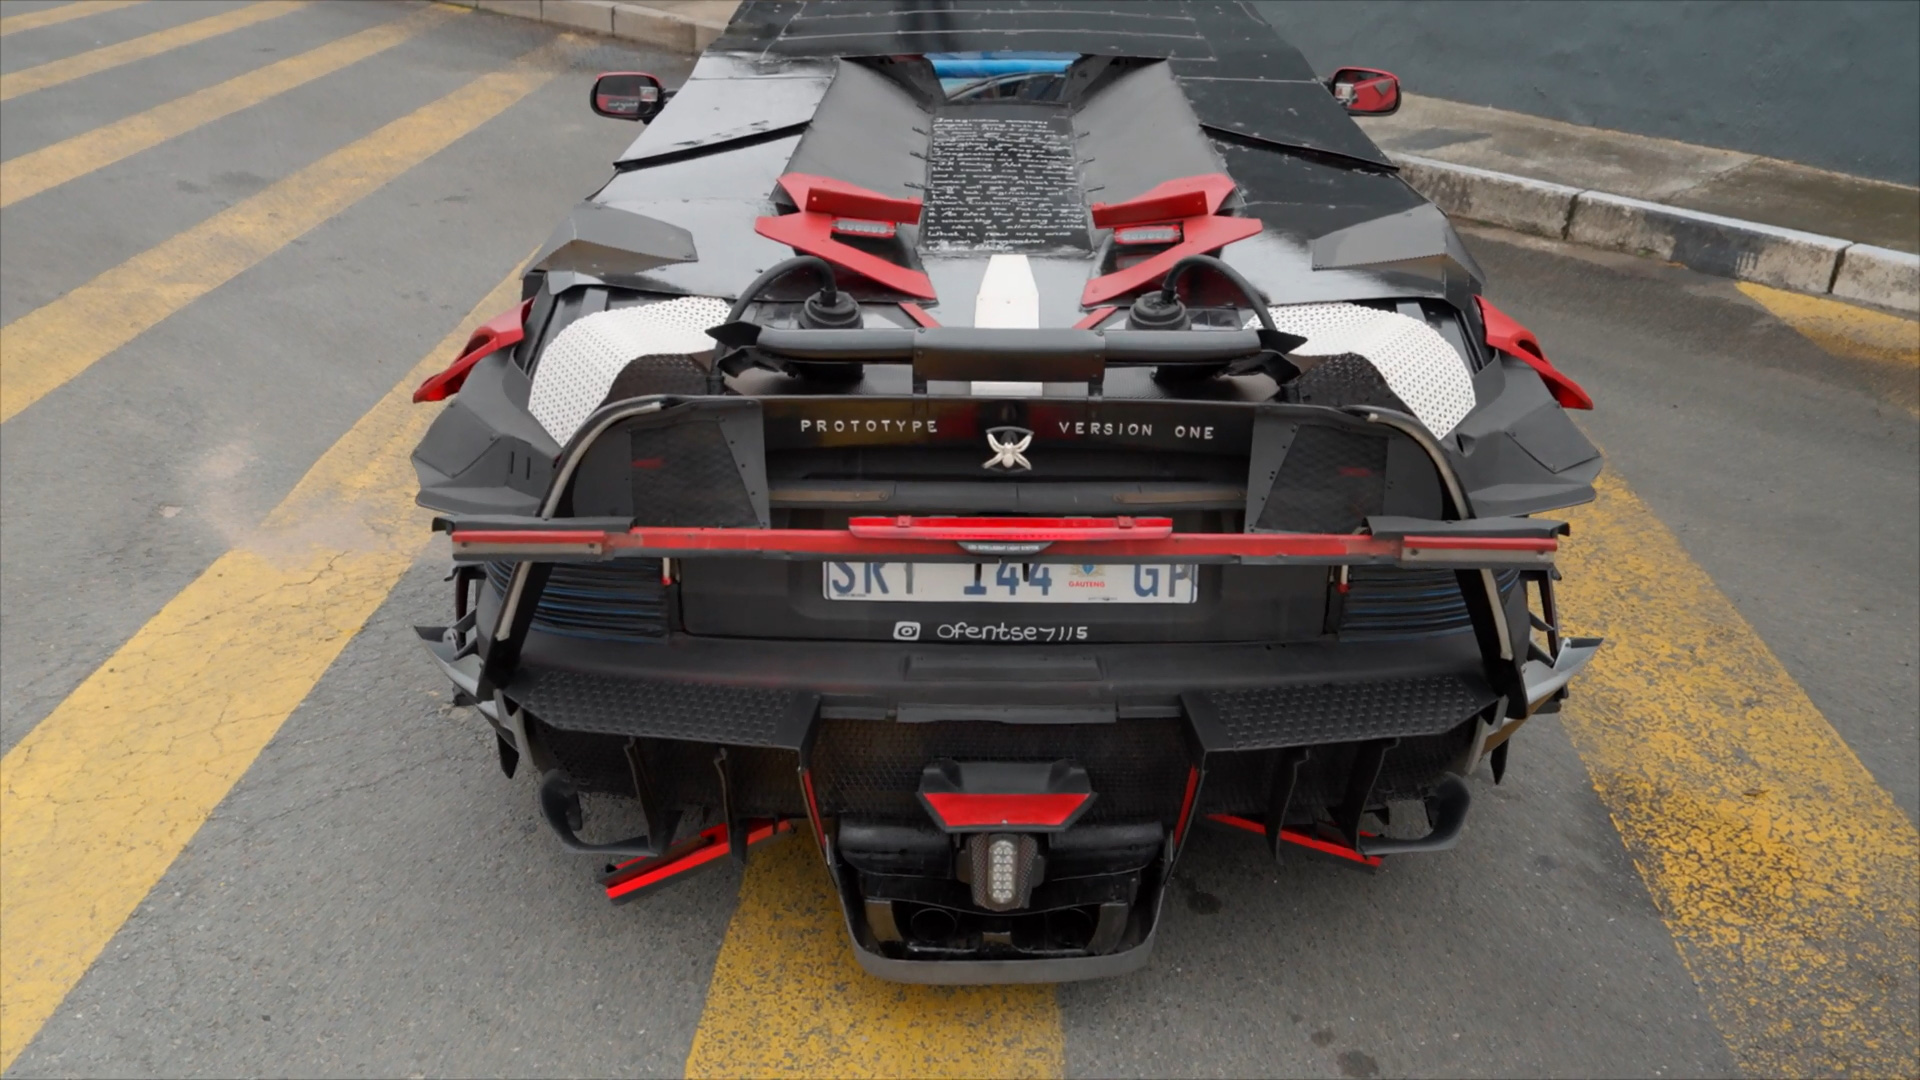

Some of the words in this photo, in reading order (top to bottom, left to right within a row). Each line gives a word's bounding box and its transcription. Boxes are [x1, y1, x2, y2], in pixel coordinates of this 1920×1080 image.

[801, 420, 938, 433] PROTOTYPE
[1059, 422, 1153, 437] VERSION
[1174, 425, 1215, 440] ONE
[1068, 580, 1106, 589] GAUTENG
